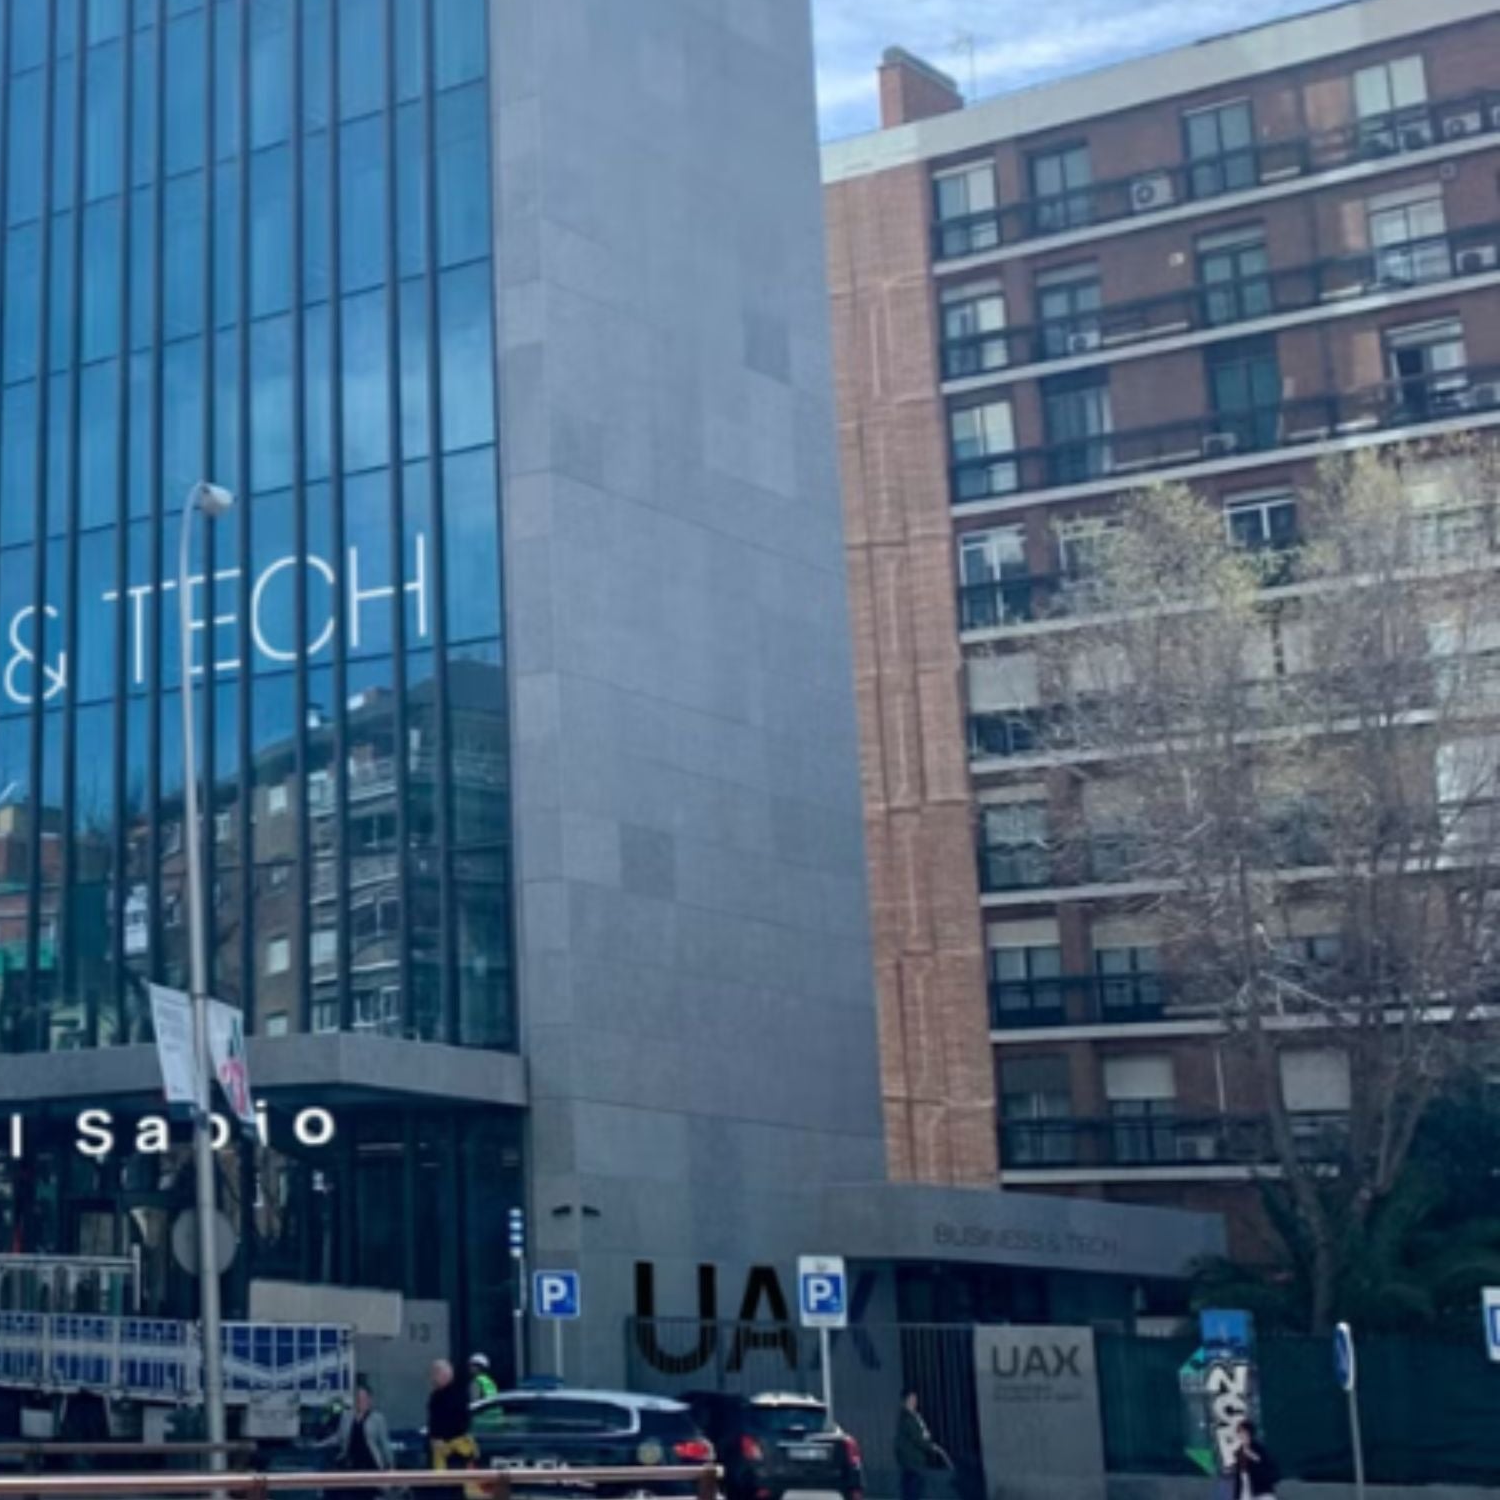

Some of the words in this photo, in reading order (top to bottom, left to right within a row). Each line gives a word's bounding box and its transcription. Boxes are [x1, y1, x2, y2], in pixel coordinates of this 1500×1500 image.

[3, 604, 67, 704] &
[102, 532, 426, 685] TECH
[543, 1278, 567, 1311] P
[807, 1277, 834, 1311] P
[991, 1344, 1081, 1377] UAX
